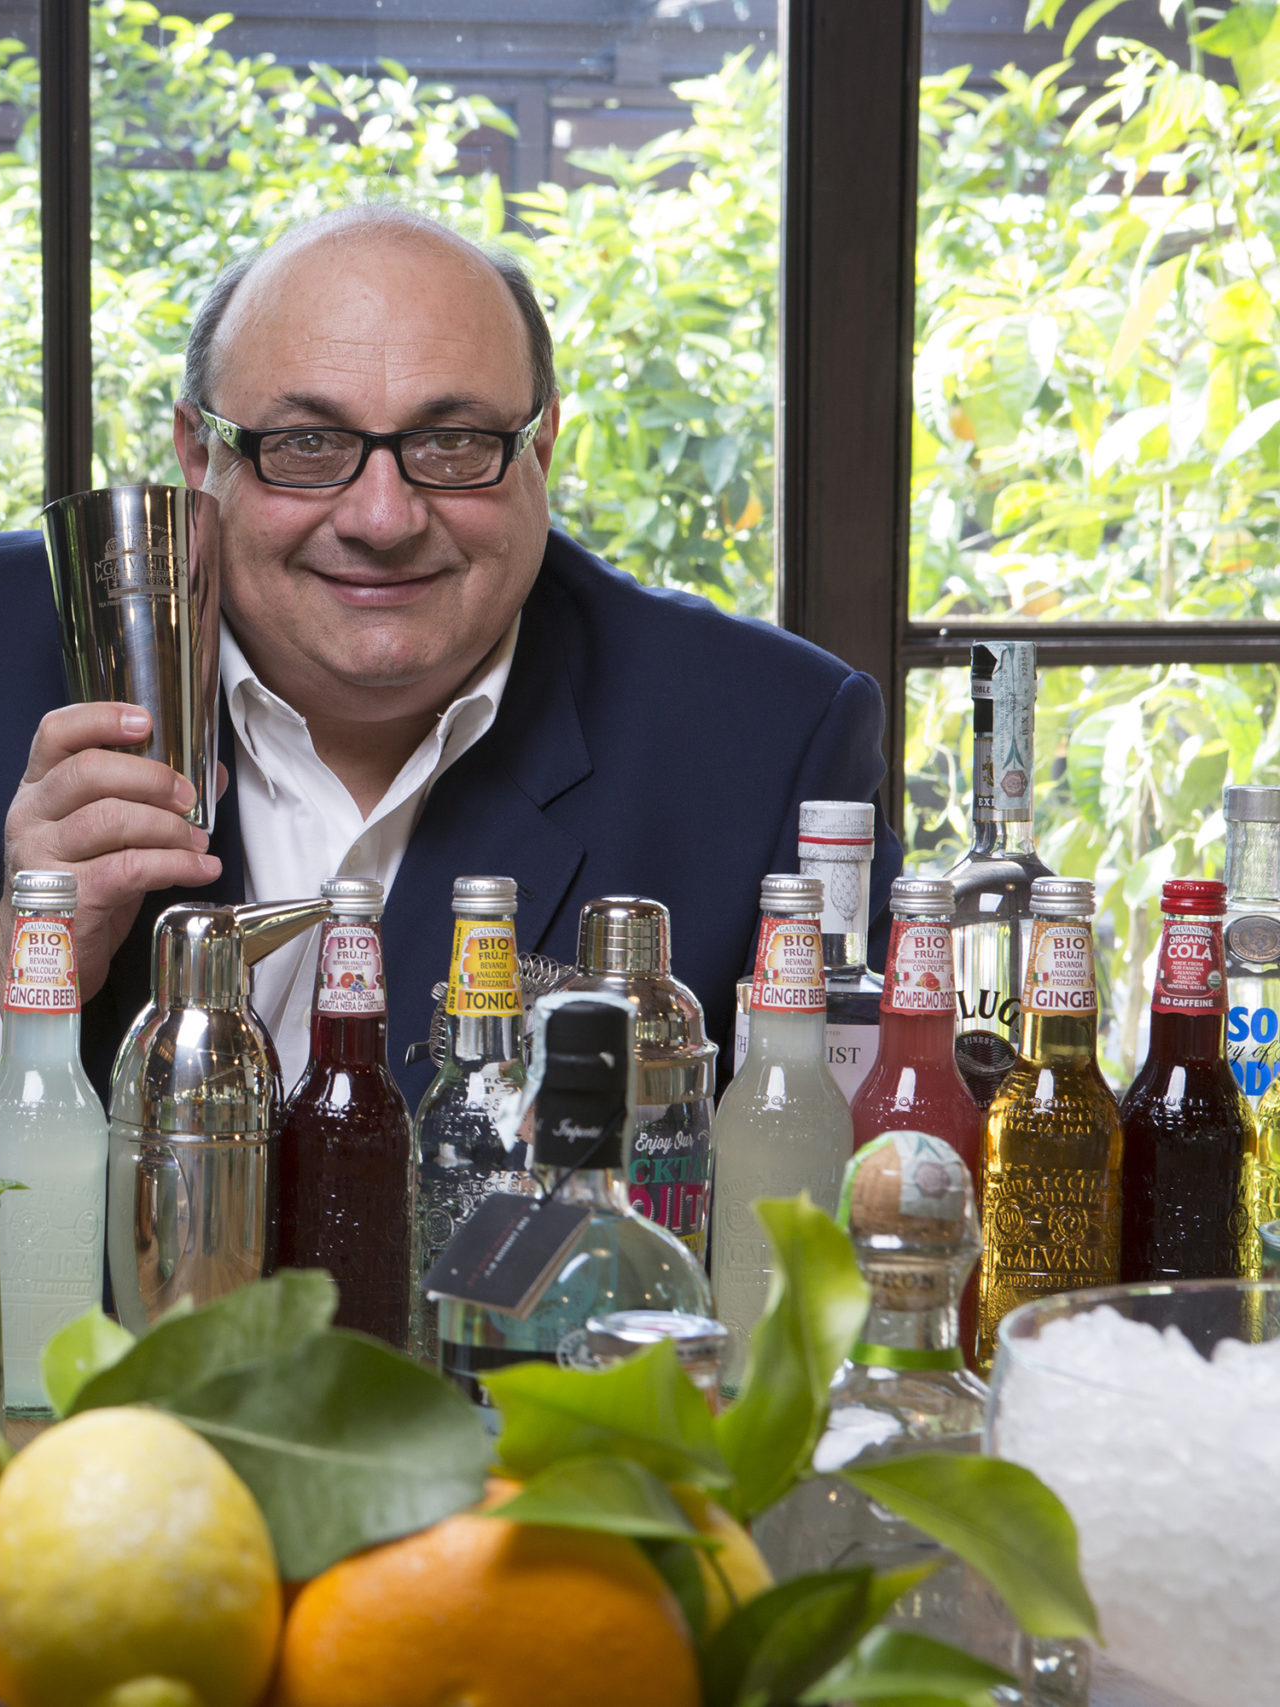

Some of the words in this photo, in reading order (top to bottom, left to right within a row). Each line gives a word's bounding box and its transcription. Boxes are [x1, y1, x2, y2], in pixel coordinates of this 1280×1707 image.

[25, 922, 65, 932] GALVANINA
[1171, 925, 1211, 935] GALVANINA
[333, 928, 372, 937] GALVANINA
[29, 933, 62, 946] BIO
[337, 937, 370, 950] BIO
[478, 938, 510, 951] BIO
[783, 934, 815, 947] BIO
[914, 936, 945, 949] BIO
[1053, 937, 1086, 950] BIO
[1169, 935, 1212, 947] ORGANIC
[1167, 944, 1213, 962] COLA
[29, 957, 58, 965] BEVANDA
[480, 961, 507, 970] BEVANDA
[785, 958, 812, 966] BEVANDA
[1055, 961, 1083, 969] BEVANDA
[25, 966, 62, 975] ANALCOLICA
[780, 967, 816, 975] ANALCOLICA
[912, 964, 926, 972] CON
[927, 964, 945, 973] POLPE
[1050, 970, 1087, 978] ANALCOLICA
[25, 975, 60, 985] FRIZZANTE
[478, 979, 509, 988] FRIZZANTE
[782, 976, 814, 984] FRIZZANTE
[10, 986, 51, 1006] GINGER
[52, 988, 76, 1006] BEER
[330, 991, 357, 1001] ARANCIA
[358, 991, 375, 1001] ROSSA
[465, 991, 521, 1010] TONICA
[763, 987, 807, 1006] GINGER
[894, 990, 940, 1009] POMPELMO
[1035, 989, 1097, 1009] GINGER
[340, 1000, 357, 1010] NERA
[1160, 996, 1172, 1005] NO
[1172, 998, 1214, 1008] CAFFEINE
[963, 1036, 996, 1047] FINEST
[634, 1132, 673, 1155] Enjoy
[673, 1130, 695, 1150] Our
